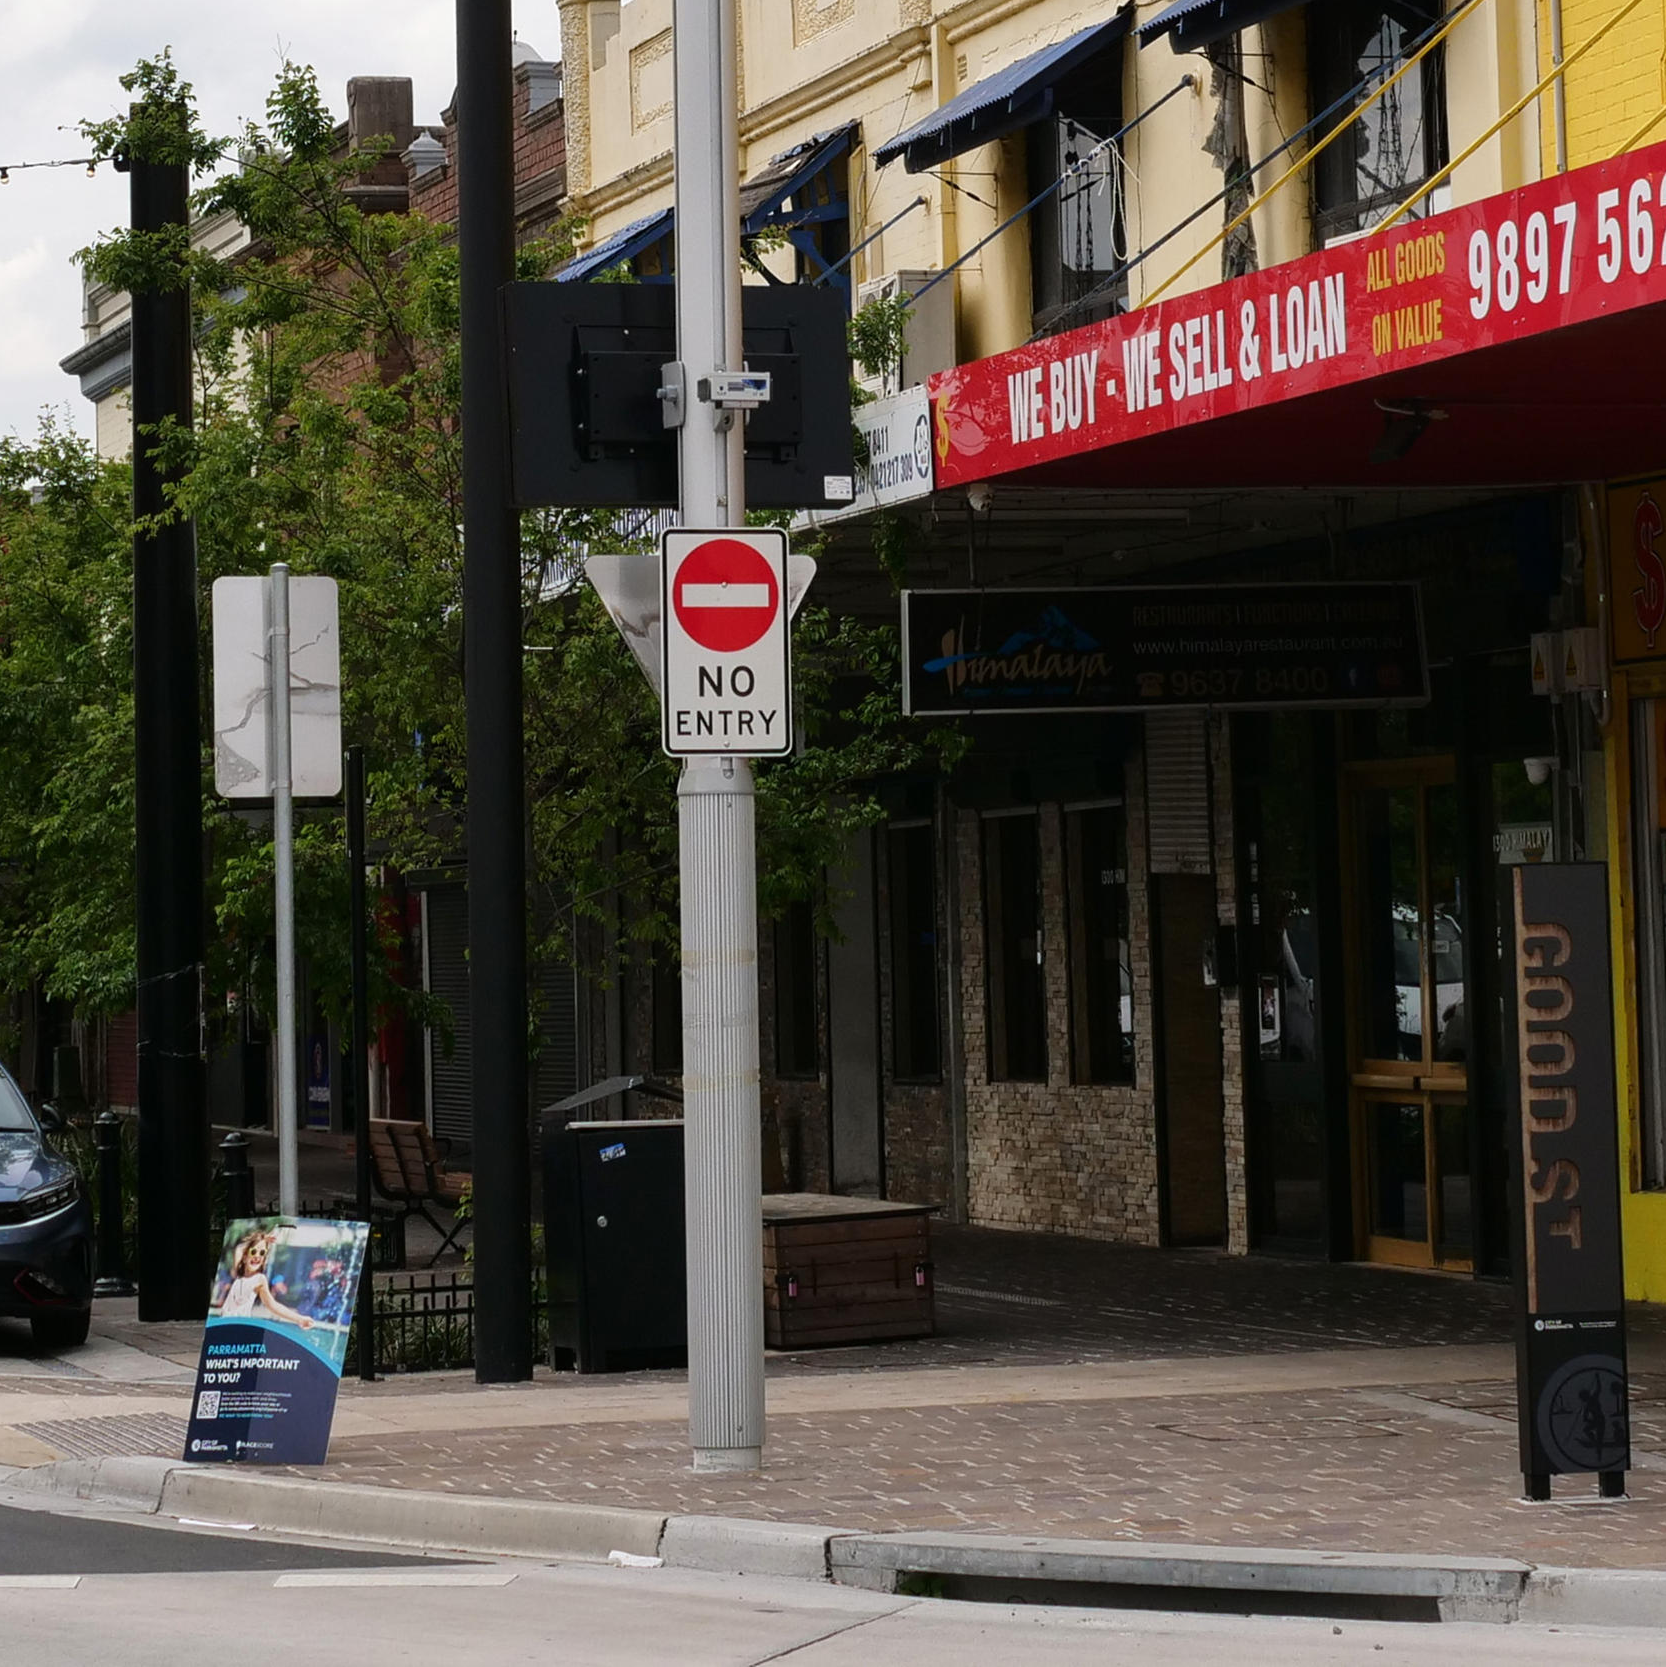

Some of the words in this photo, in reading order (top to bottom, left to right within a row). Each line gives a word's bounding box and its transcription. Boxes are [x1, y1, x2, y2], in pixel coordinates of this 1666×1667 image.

[1366, 242, 1391, 293] ALL
[1394, 228, 1446, 286] GOODS
[1467, 202, 1579, 320] 9897
[1372, 314, 1392, 358] ON
[1395, 295, 1443, 351] VALUE
[1007, 368, 1045, 446] WE
[1049, 347, 1098, 437] BUY
[1122, 333, 1162, 415] WE
[1168, 308, 1235, 403] SELL
[1237, 305, 1261, 380] &
[1269, 272, 1347, 373] LOAN
[698, 665, 756, 698] NO
[1255, 666, 1329, 695] 8400
[676, 709, 778, 737] ENTRY
[1521, 922, 1579, 1135] GOOD
[1530, 1157, 1582, 1250] ST
[206, 1358, 240, 1369] WHAT'S
[240, 1358, 300, 1370] IMPORTANT
[208, 1344, 267, 1355] PARRAMATTA
[203, 1373, 216, 1384] TO
[217, 1372, 241, 1383] YOU?
